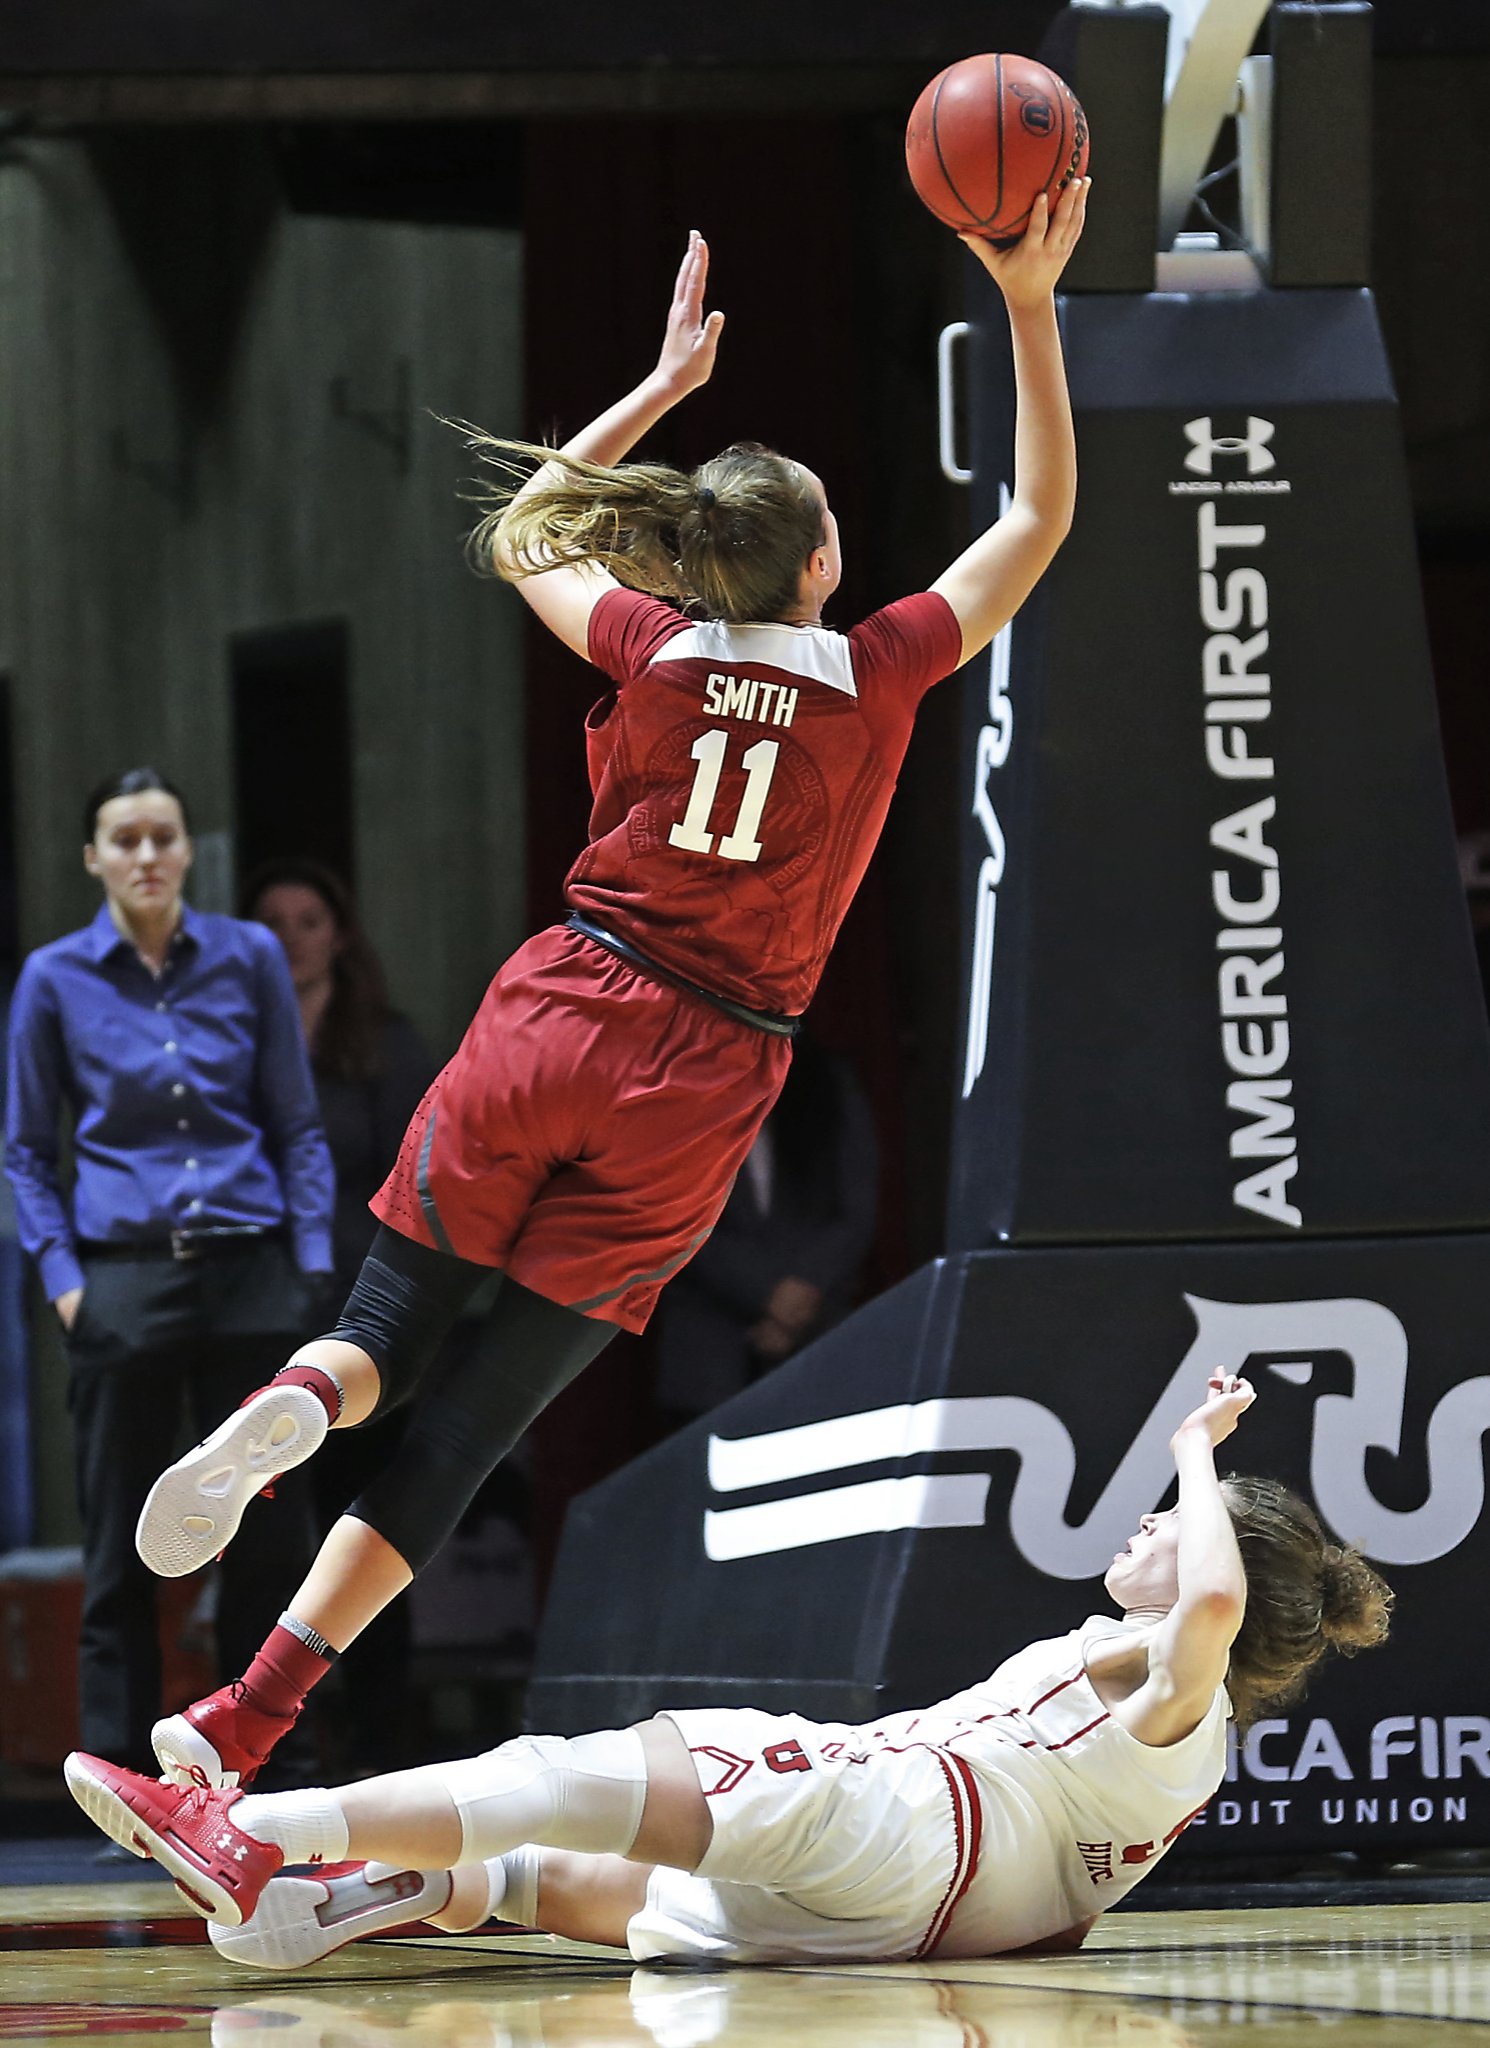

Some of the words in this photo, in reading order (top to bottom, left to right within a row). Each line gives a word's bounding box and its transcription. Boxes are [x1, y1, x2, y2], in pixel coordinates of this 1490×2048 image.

[1197, 501, 1275, 779] FIRST
[703, 673, 799, 728] SMITH
[668, 729, 780, 863] 11
[1209, 796, 1304, 1229] AMERICA
[1224, 1717, 1354, 1782] ICA
[1321, 1797, 1468, 1825] UNION
